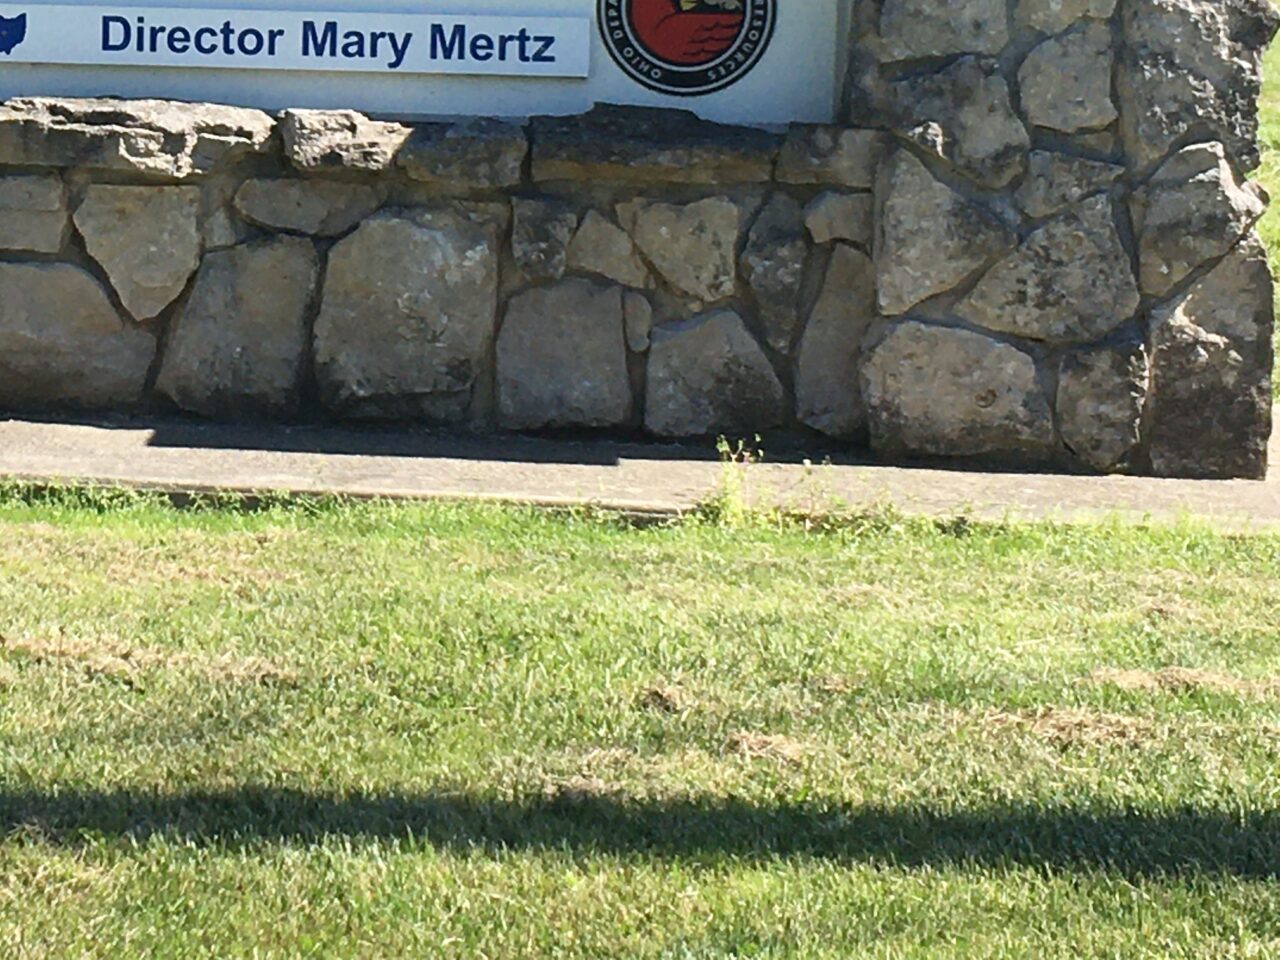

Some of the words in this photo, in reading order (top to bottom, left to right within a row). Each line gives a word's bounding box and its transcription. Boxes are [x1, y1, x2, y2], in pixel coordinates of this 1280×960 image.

[101, 15, 285, 56] Director
[301, 20, 413, 69] Mary
[429, 23, 556, 63] Mertz
[622, 46, 662, 80] OHIO
